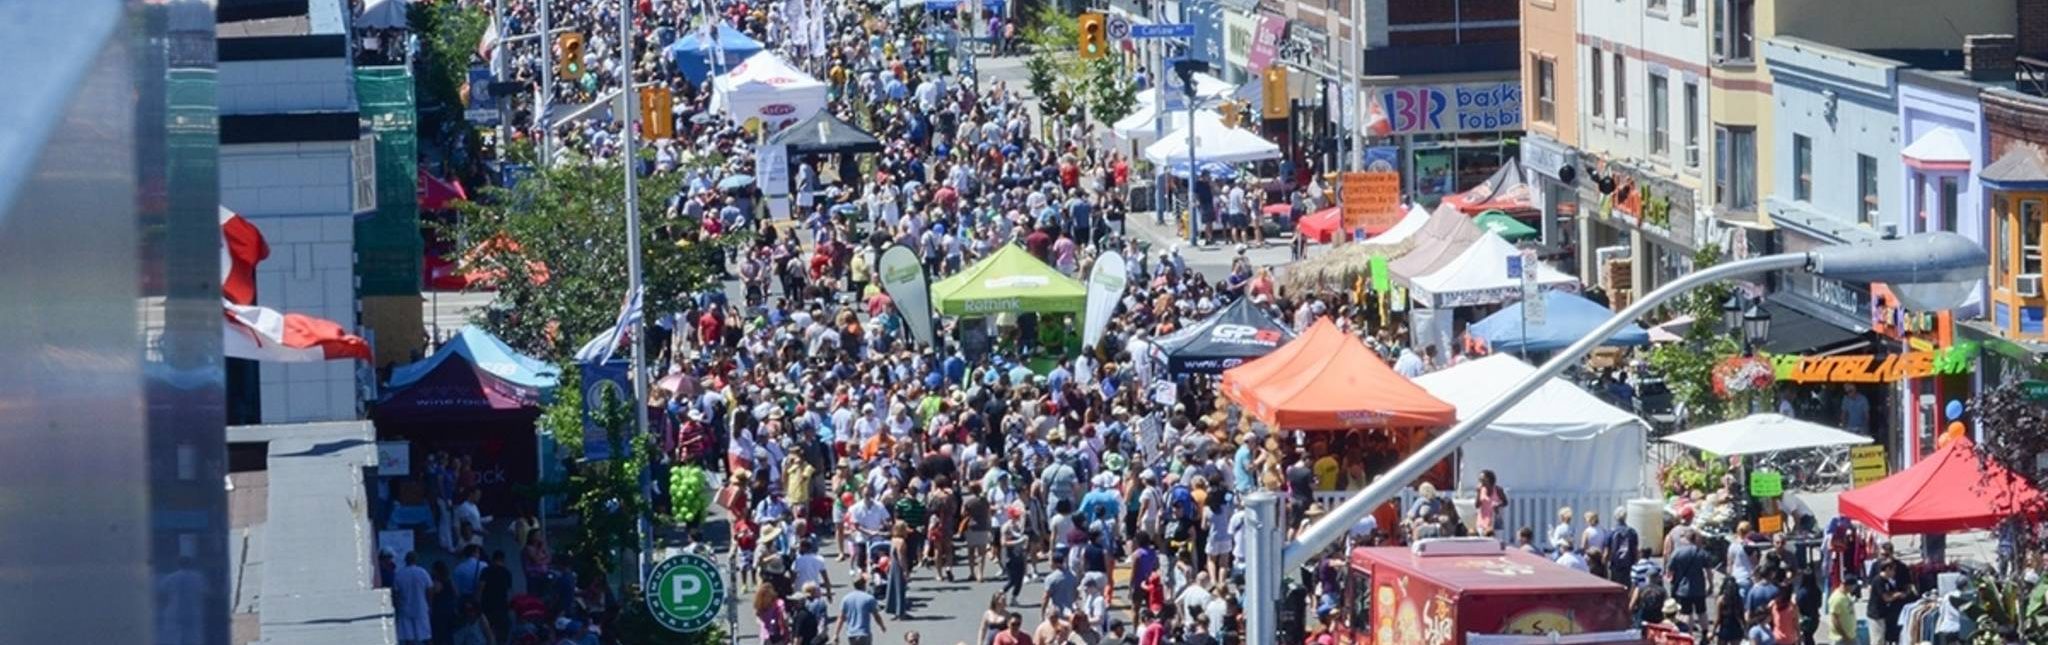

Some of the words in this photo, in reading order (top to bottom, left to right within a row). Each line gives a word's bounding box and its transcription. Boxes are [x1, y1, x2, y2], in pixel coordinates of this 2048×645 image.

[1142, 25, 1174, 36] Carlaw
[1384, 89, 1446, 131] BR
[1344, 185, 1398, 194] CONSTRUCTION
[964, 299, 1021, 313] Rethink
[416, 398, 454, 406] wine
[457, 398, 489, 406] rack
[651, 556, 720, 591] MUNICIPAL
[672, 574, 702, 604] P
[652, 599, 721, 628] PARKING
